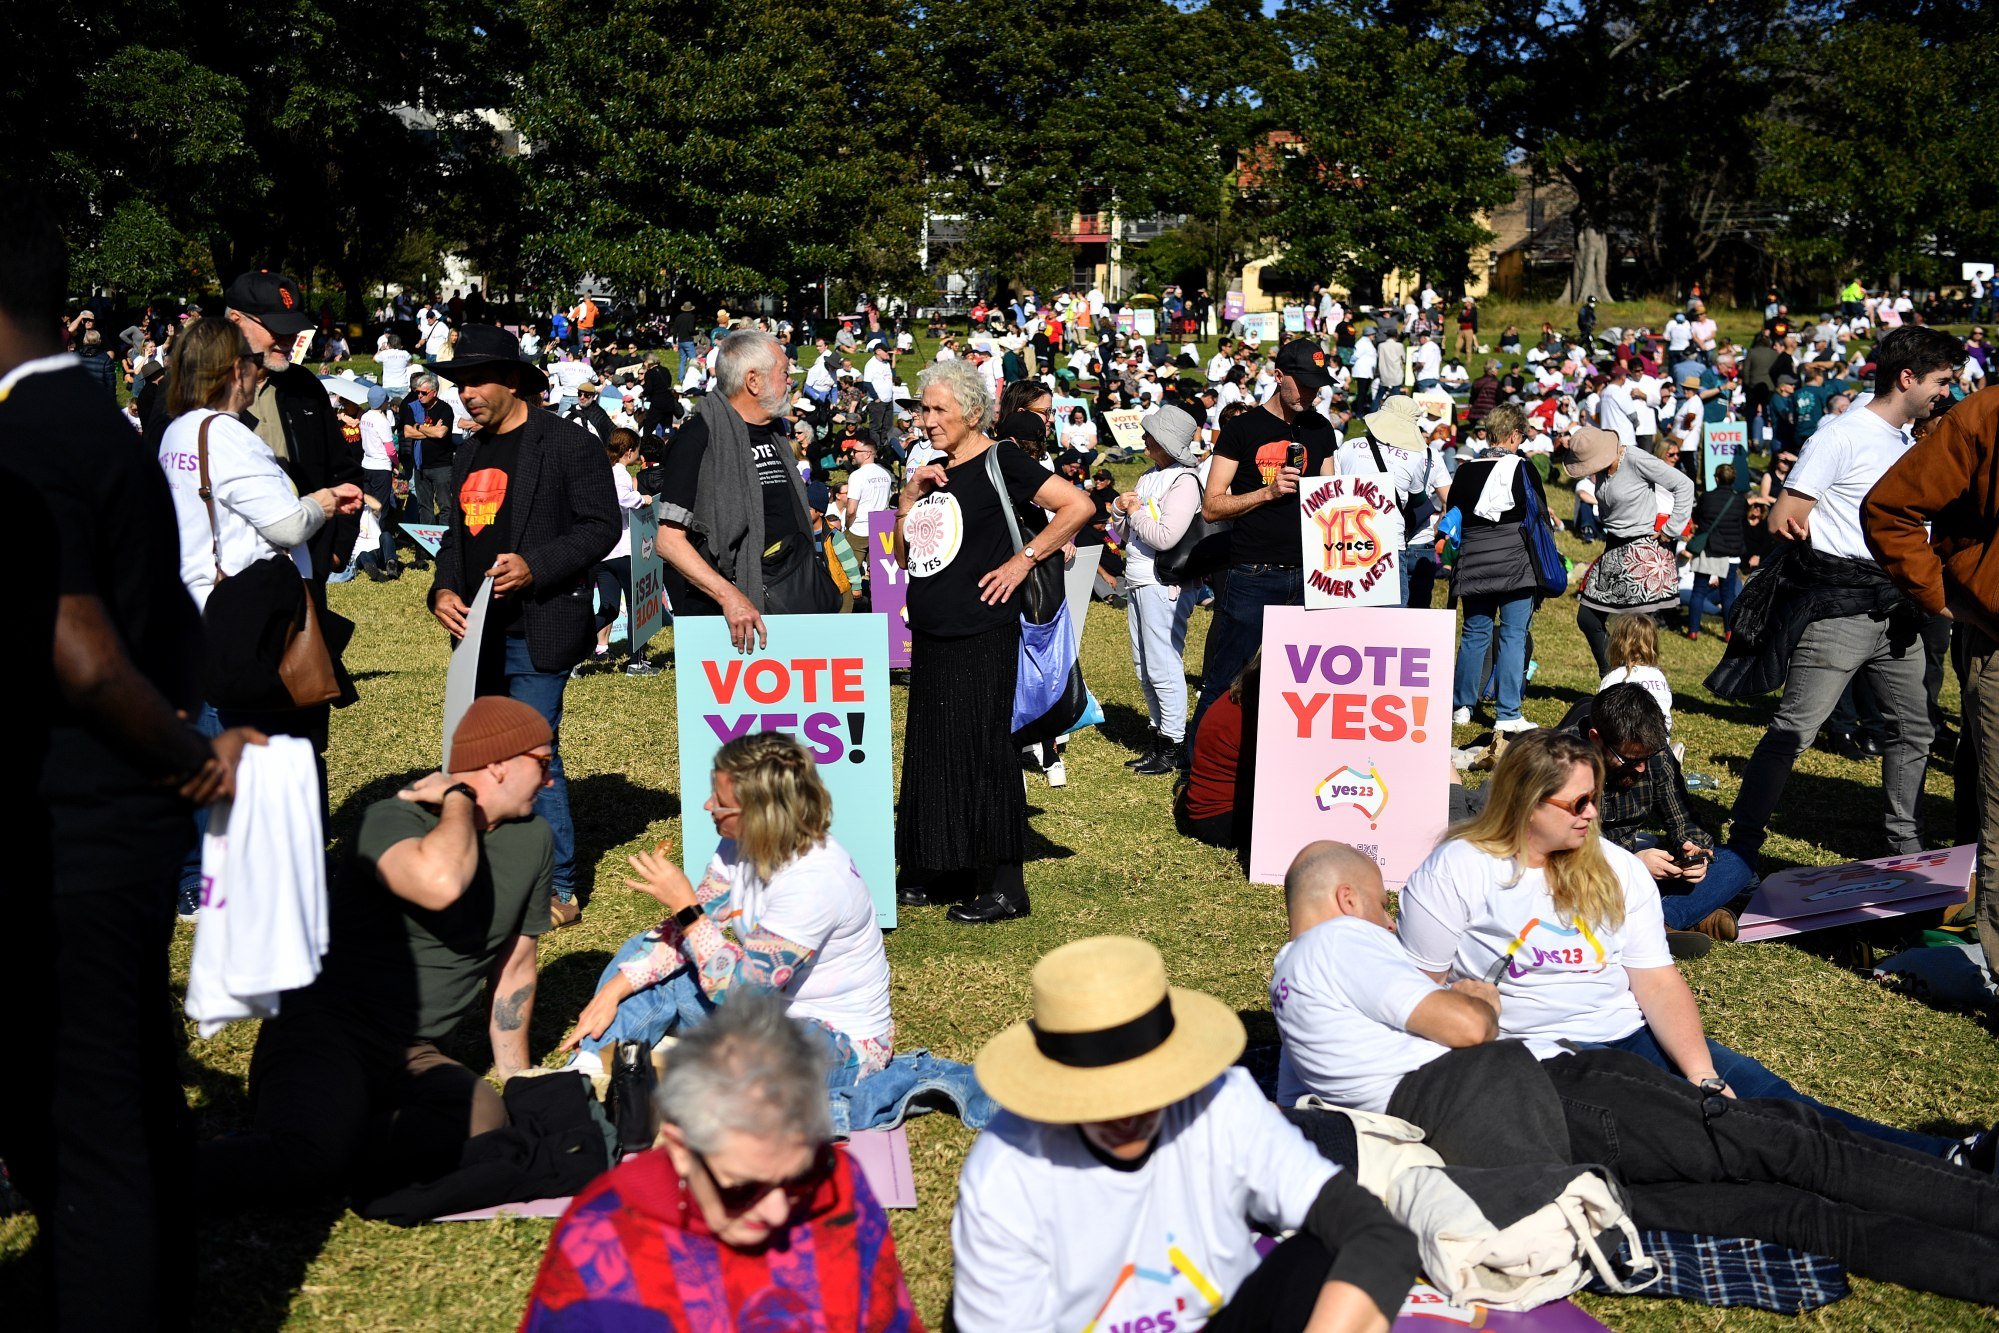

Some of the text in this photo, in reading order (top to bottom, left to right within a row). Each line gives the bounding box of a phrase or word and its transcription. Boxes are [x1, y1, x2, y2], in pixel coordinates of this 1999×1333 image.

[1710, 431, 1741, 442] VOTE
[751, 444, 773, 460] OTE
[1352, 441, 1408, 460] VOE YES
[170, 452, 199, 471] YES
[1424, 458, 1434, 468] ES
[1262, 467, 1276, 477] THE
[1301, 477, 1395, 518] INNER WEST
[1313, 504, 1382, 572] YES
[1324, 540, 1374, 551] VOICE
[923, 557, 941, 572] YES
[1307, 552, 1395, 598] INNER WEST
[636, 598, 659, 630] VOTE
[1284, 644, 1431, 687] VOTE
[701, 658, 865, 704] VOTE
[1641, 680, 1660, 690] OTE
[1281, 691, 1429, 743] YES!
